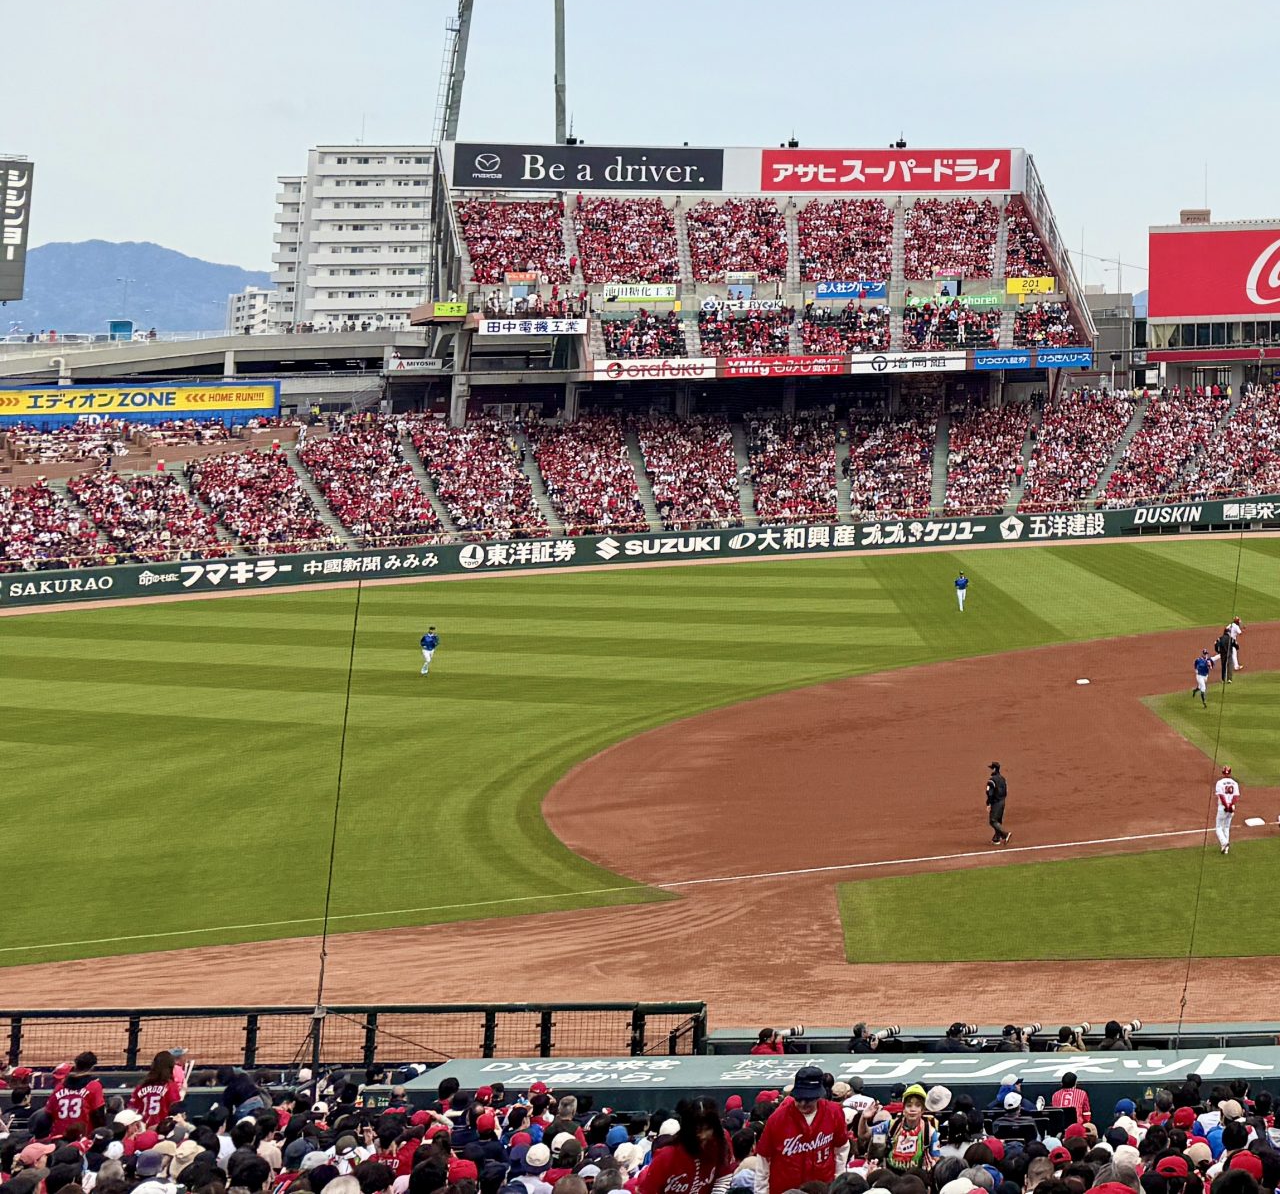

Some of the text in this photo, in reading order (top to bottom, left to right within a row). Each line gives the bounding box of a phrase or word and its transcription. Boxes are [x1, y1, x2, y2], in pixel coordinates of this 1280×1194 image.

[520, 154, 705, 183] Be a driver.
[772, 158, 1001, 183] アサヒスーパードライ
[3, 170, 28, 261] シシンヨー
[605, 286, 675, 298] 池田糖化工業
[1022, 279, 1039, 287] 201
[487, 320, 579, 333] 田中電機工業
[772, 358, 841, 374] もみじ銀行
[892, 355, 946, 368] 増岡組
[977, 356, 1027, 365] ひろぎん証券
[1038, 353, 1090, 364] ひろぎんリース
[26, 393, 114, 409] エディオン
[117, 391, 177, 407] ZONE
[208, 392, 234, 402] HOME
[1134, 506, 1202, 524] DUSKIN
[1028, 513, 1105, 538] 五洋建設
[625, 535, 720, 554] SUZUKI
[758, 526, 855, 550] 大和興産
[485, 540, 576, 566] 東洋証券
[139, 559, 292, 587] 命のそばに フマキラー
[303, 553, 438, 575] 中國新聞 みみみ
[9, 576, 114, 597] SAKURAO
[480, 1059, 682, 1072] DXの未来を
[734, 1058, 826, 1070] 株式
[838, 1052, 1275, 1079] サンネット
[503, 1071, 667, 1084] 広島から。
[58, 1097, 83, 1119] 33
[142, 1095, 161, 1115] 15
[782, 1130, 834, 1156] Hiroshima
